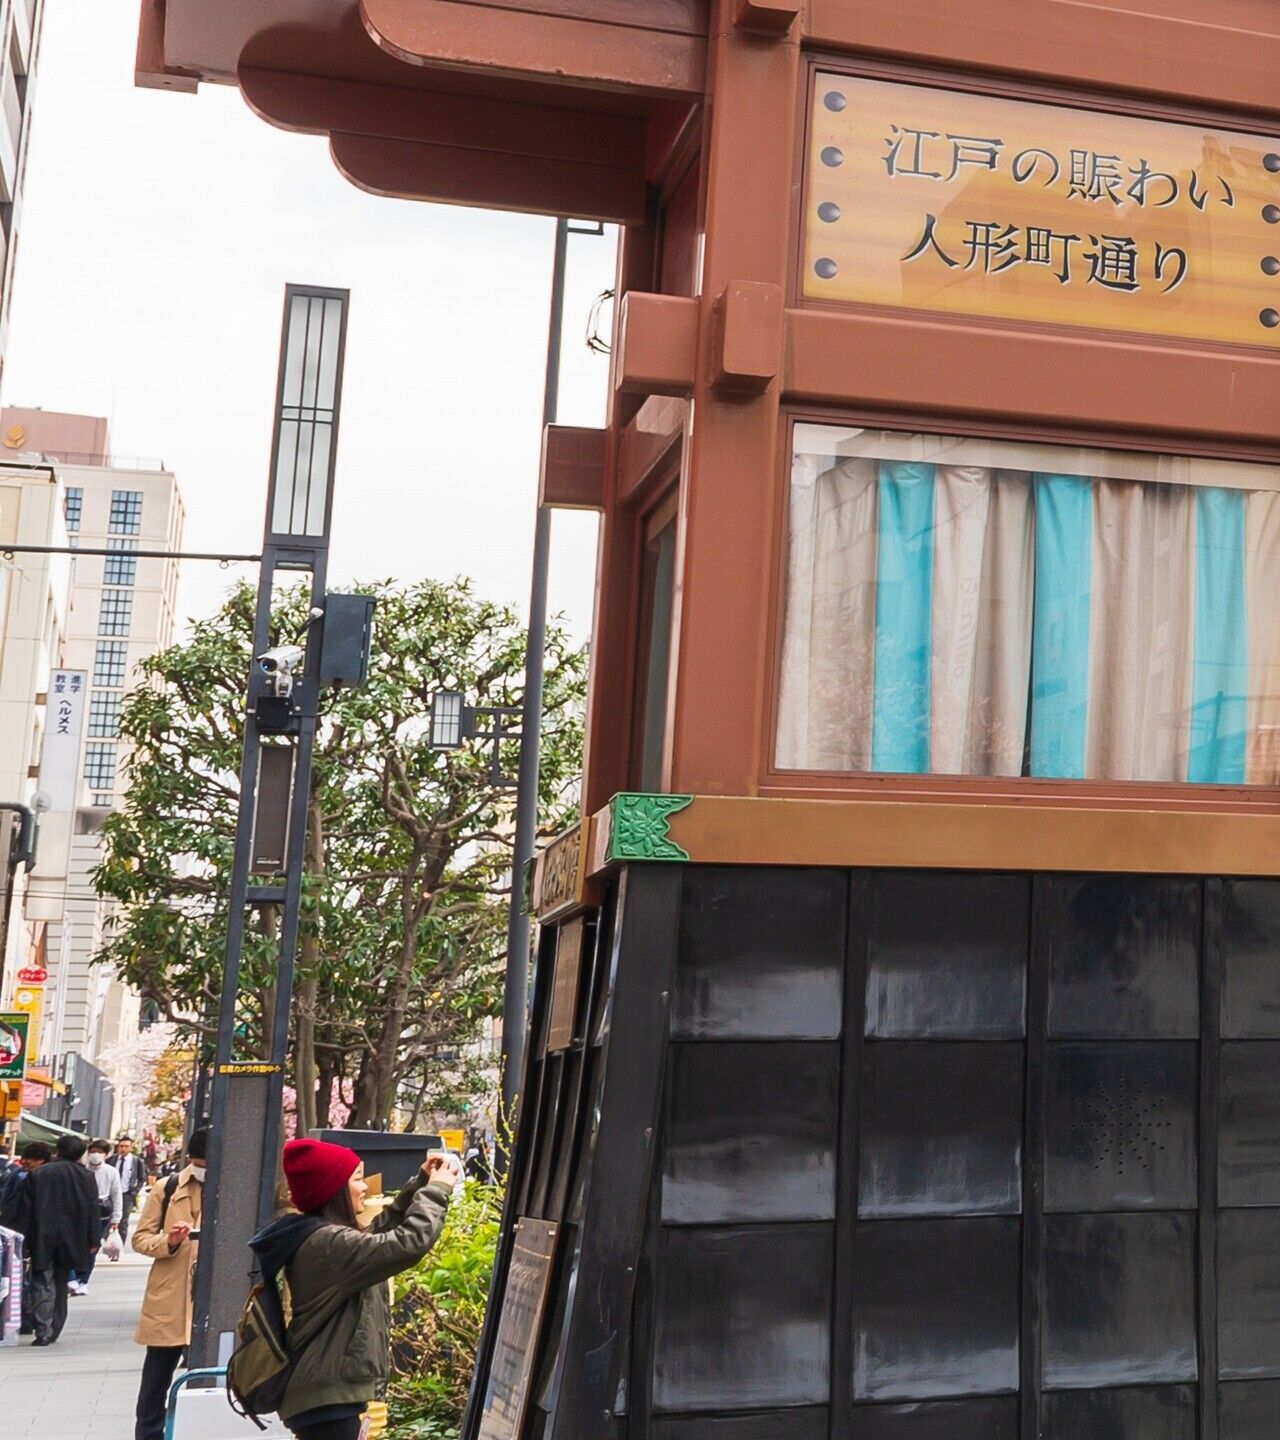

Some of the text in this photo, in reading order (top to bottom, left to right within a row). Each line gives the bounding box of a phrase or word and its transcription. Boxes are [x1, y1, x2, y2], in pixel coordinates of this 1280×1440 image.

[880, 123, 1237, 213] 江戸の賑わい
[899, 212, 1189, 295] 人形町通り
[57, 699, 72, 735] ヘルメス
